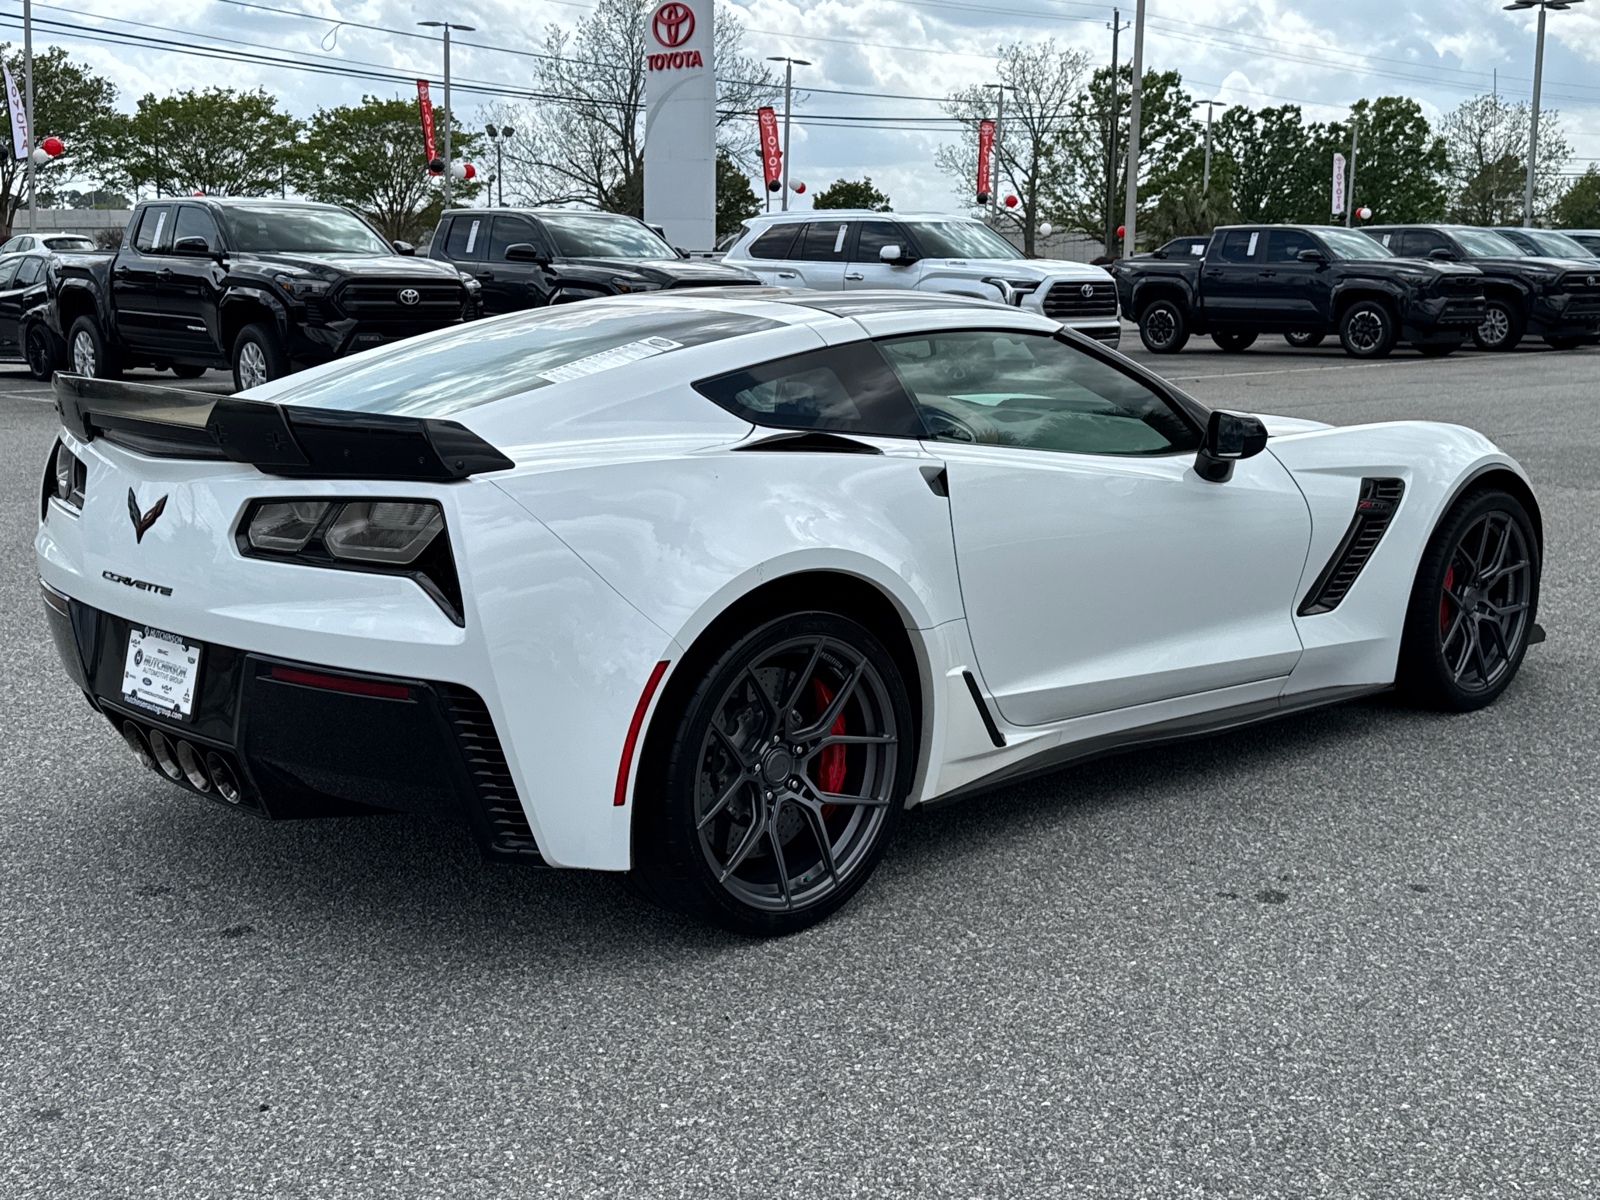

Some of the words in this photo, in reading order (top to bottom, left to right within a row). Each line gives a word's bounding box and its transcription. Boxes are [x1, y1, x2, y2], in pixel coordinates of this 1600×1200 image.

[646, 50, 703, 71] TOYOTA
[421, 101, 436, 160] TOYOT
[766, 126, 777, 181] TOYOT
[1335, 166, 1343, 209] TOYOTA
[102, 570, 173, 597] CORVETTE
[151, 628, 183, 645] HUTCHINSON
[142, 667, 169, 681] AUTOMOTIVE
[169, 674, 184, 685] GROUP
[143, 656, 188, 678] HUTCHINSON
